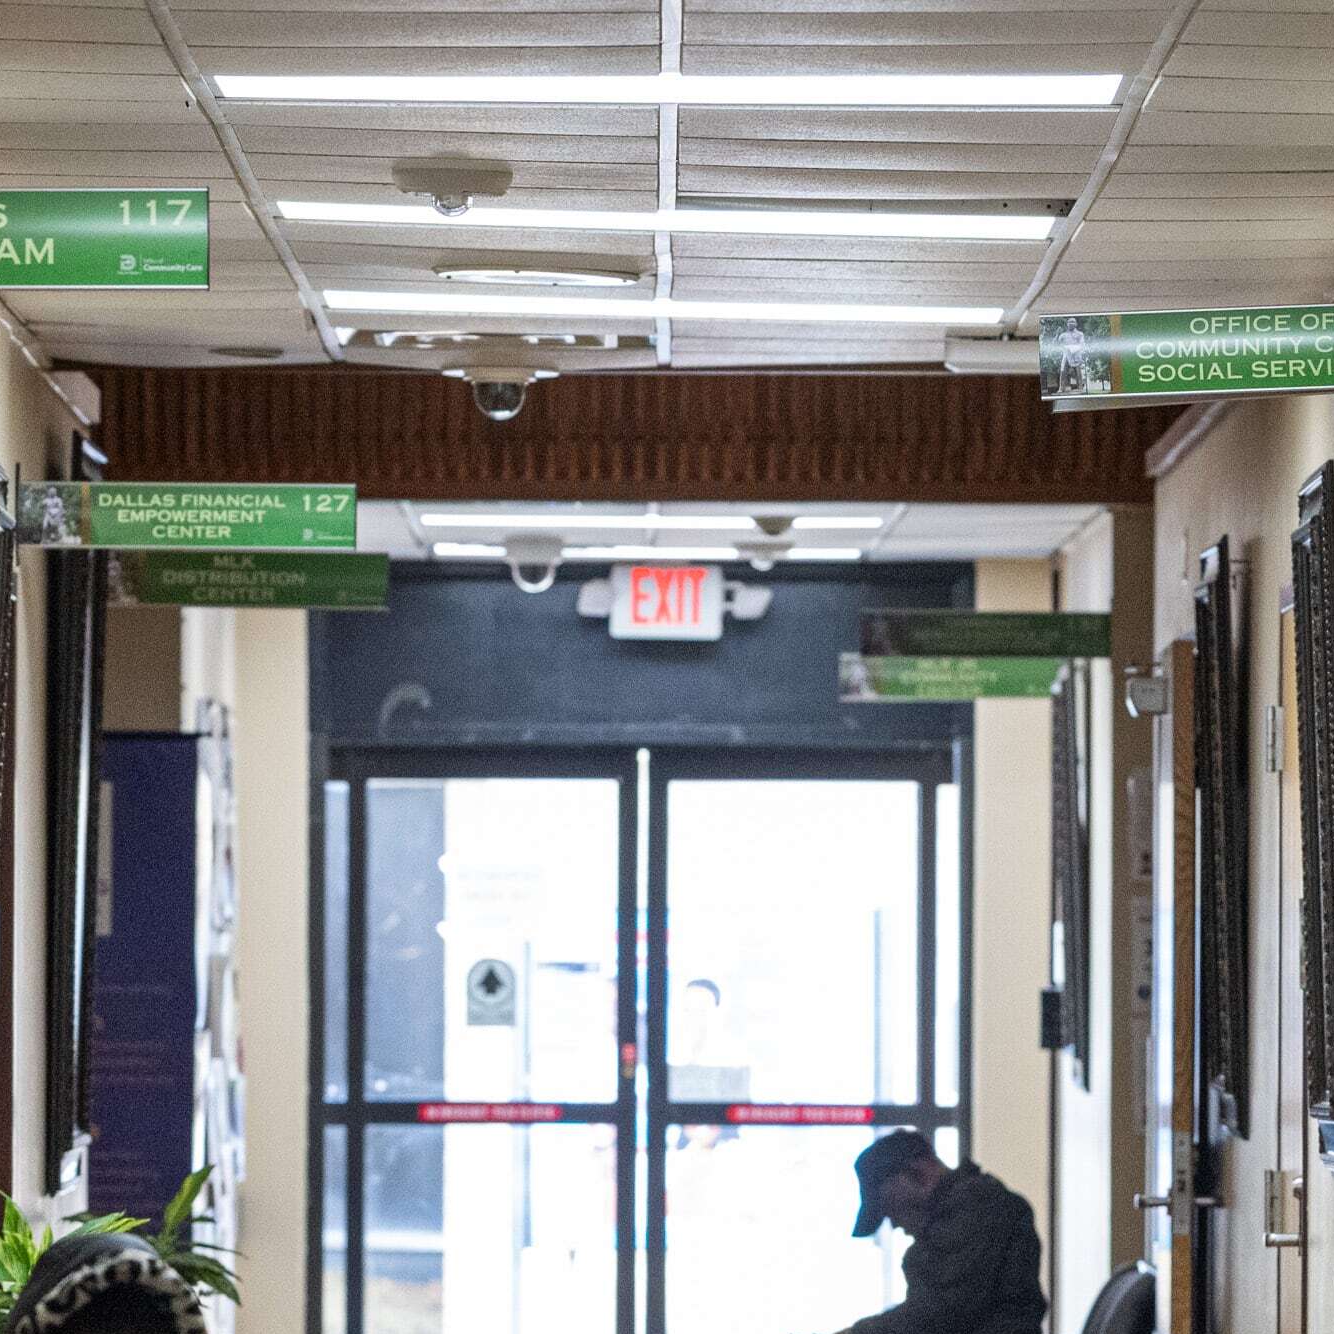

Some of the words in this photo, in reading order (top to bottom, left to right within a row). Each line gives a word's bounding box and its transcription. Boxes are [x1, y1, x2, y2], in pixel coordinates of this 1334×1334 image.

[118, 199, 193, 227] 117
[1189, 313, 1291, 335] OFFICE
[1135, 336, 1304, 359] COMMUNITY
[1138, 360, 1244, 383] SOCIAL
[98, 493, 176, 508] DALLAS
[181, 493, 286, 509] FINANCIAL
[301, 494, 350, 513] 127
[118, 509, 267, 524] EMPOWERMENT
[152, 525, 232, 539] CENTER
[161, 569, 307, 586] DISTRIBUTION
[193, 586, 276, 601] CENTER
[630, 566, 708, 624] EXIT
